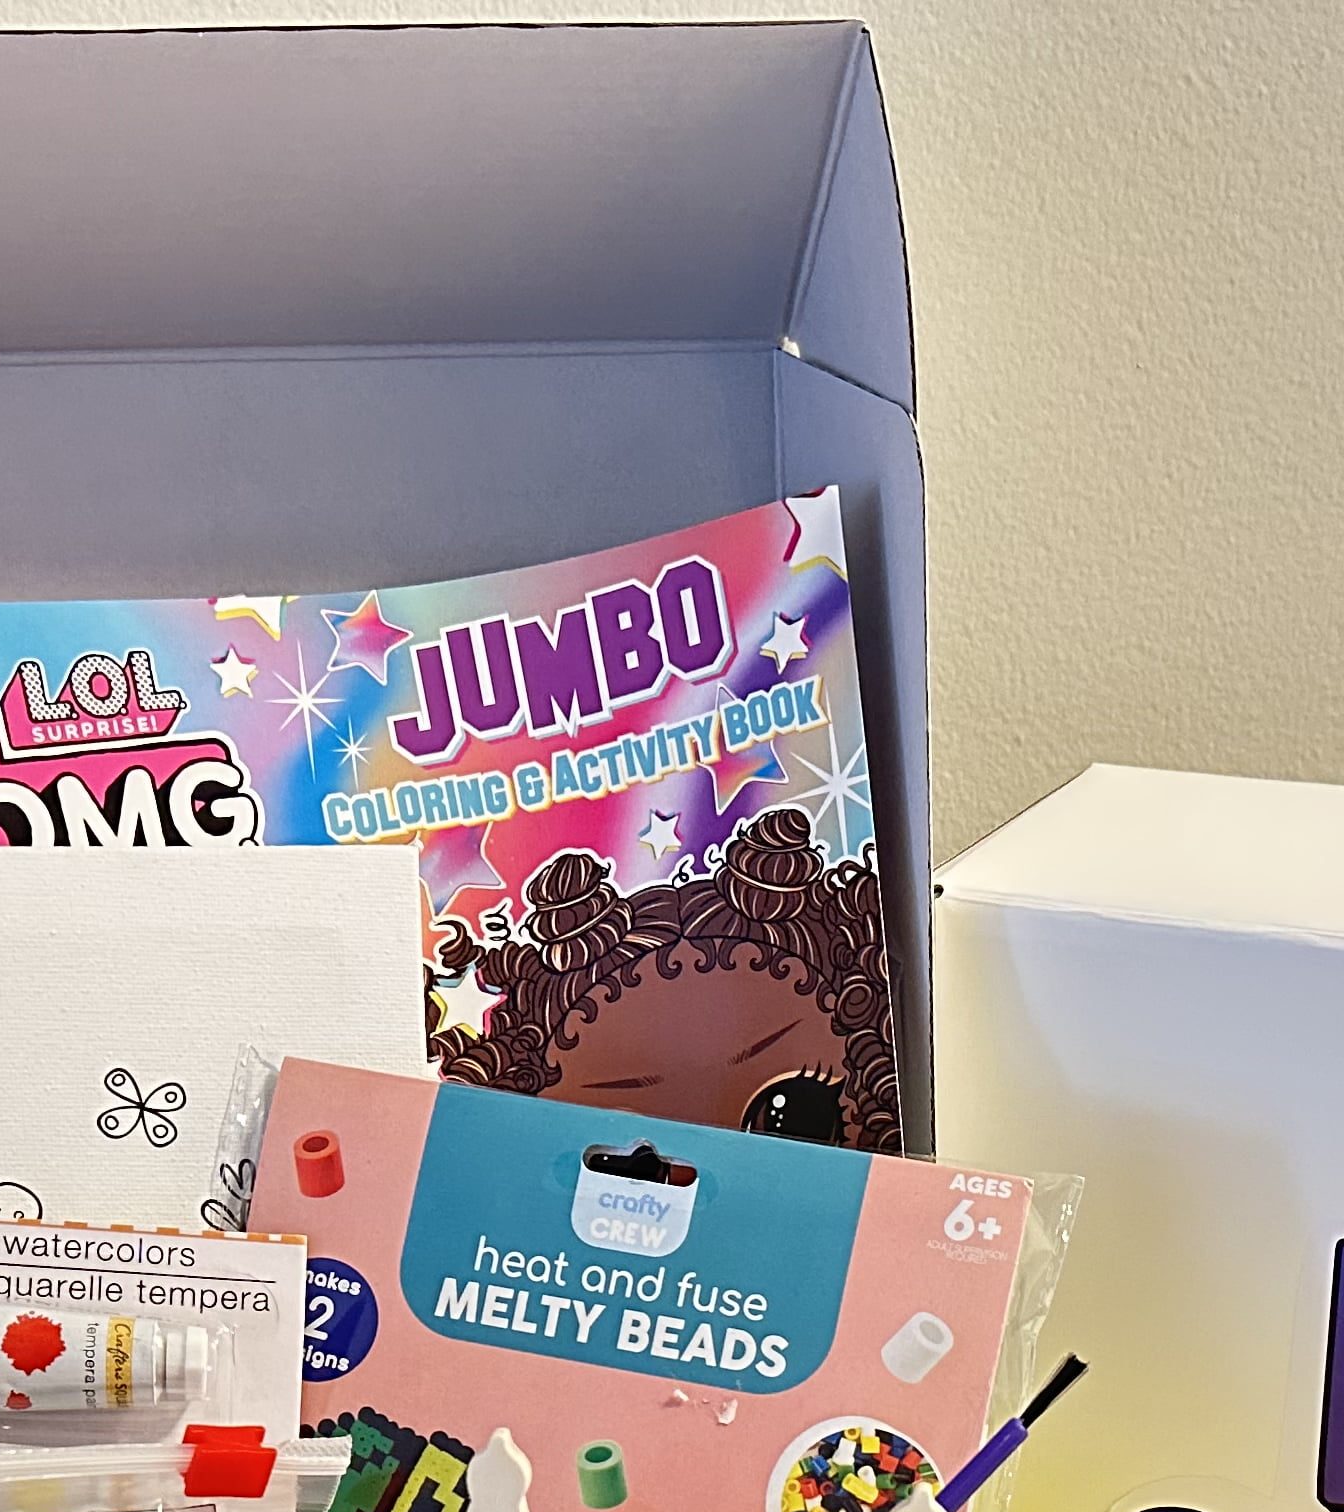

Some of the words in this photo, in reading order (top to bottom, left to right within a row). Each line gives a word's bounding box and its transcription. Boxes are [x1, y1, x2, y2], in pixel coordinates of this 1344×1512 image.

[393, 561, 724, 758] JUMBO
[31, 716, 158, 744] SURPRISE!
[325, 773, 509, 838] COLORING
[518, 768, 548, 806] &
[554, 718, 715, 797] ACTIVITY
[727, 681, 823, 744] BOOK
[949, 1173, 1012, 1198] AGES
[598, 1192, 671, 1222] crafty
[944, 1199, 1002, 1241] 6+
[3, 1233, 196, 1267] watercolors
[590, 1217, 668, 1249] CREW
[474, 1235, 569, 1287] heat
[581, 1266, 665, 1302] and
[677, 1272, 768, 1321] fuse
[137, 1279, 270, 1313] tempera
[434, 1277, 607, 1344] MELTY
[616, 1309, 790, 1378] BEADS
[82, 1323, 100, 1384] tempera
[303, 1344, 350, 1372] igns
